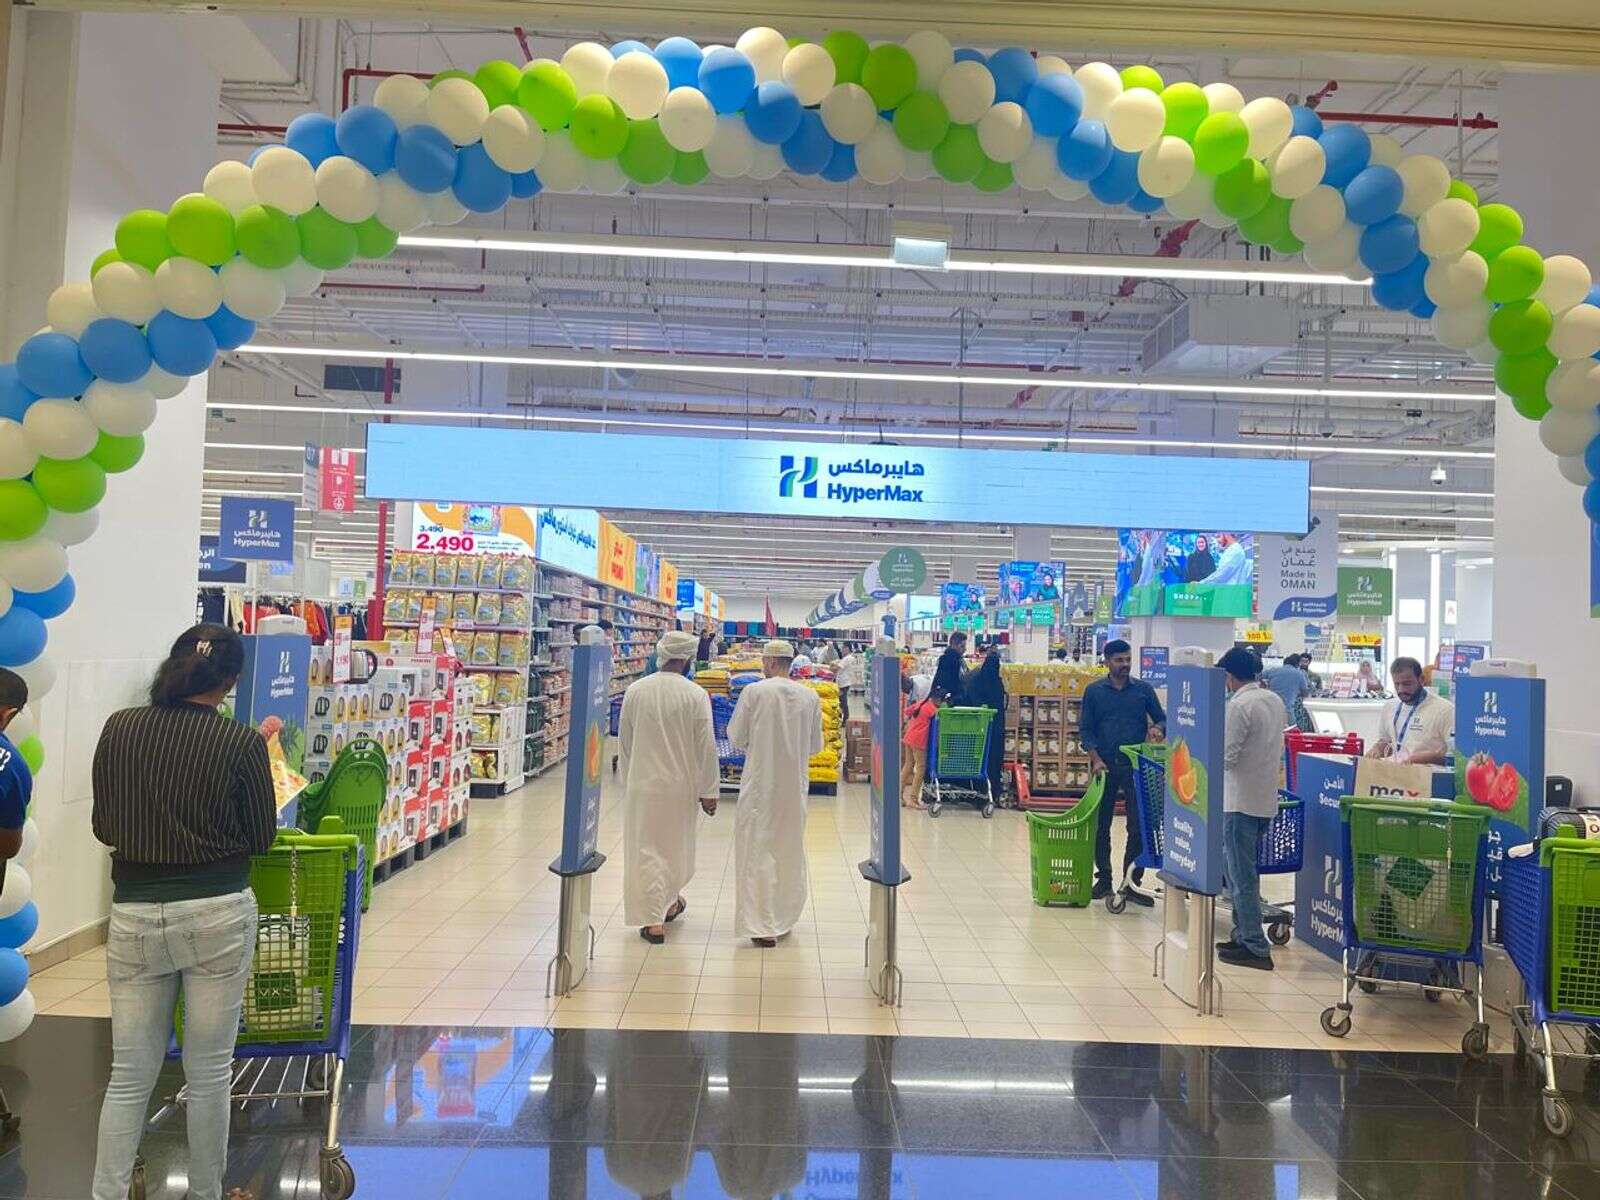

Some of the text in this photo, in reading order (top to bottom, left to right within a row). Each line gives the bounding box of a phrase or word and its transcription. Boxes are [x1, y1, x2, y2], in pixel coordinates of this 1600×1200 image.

[828, 458, 925, 479] هايبرماكس
[827, 483, 924, 503] HyperMax
[234, 529, 280, 540] هايبرماكس
[419, 525, 444, 533] 3.490
[233, 537, 280, 549] HyperMax
[416, 533, 474, 552] 2.490
[1281, 570, 1302, 578] Made
[1281, 579, 1315, 590] OMAN
[1475, 725, 1507, 737] HyperMax
[1369, 784, 1420, 797] max
